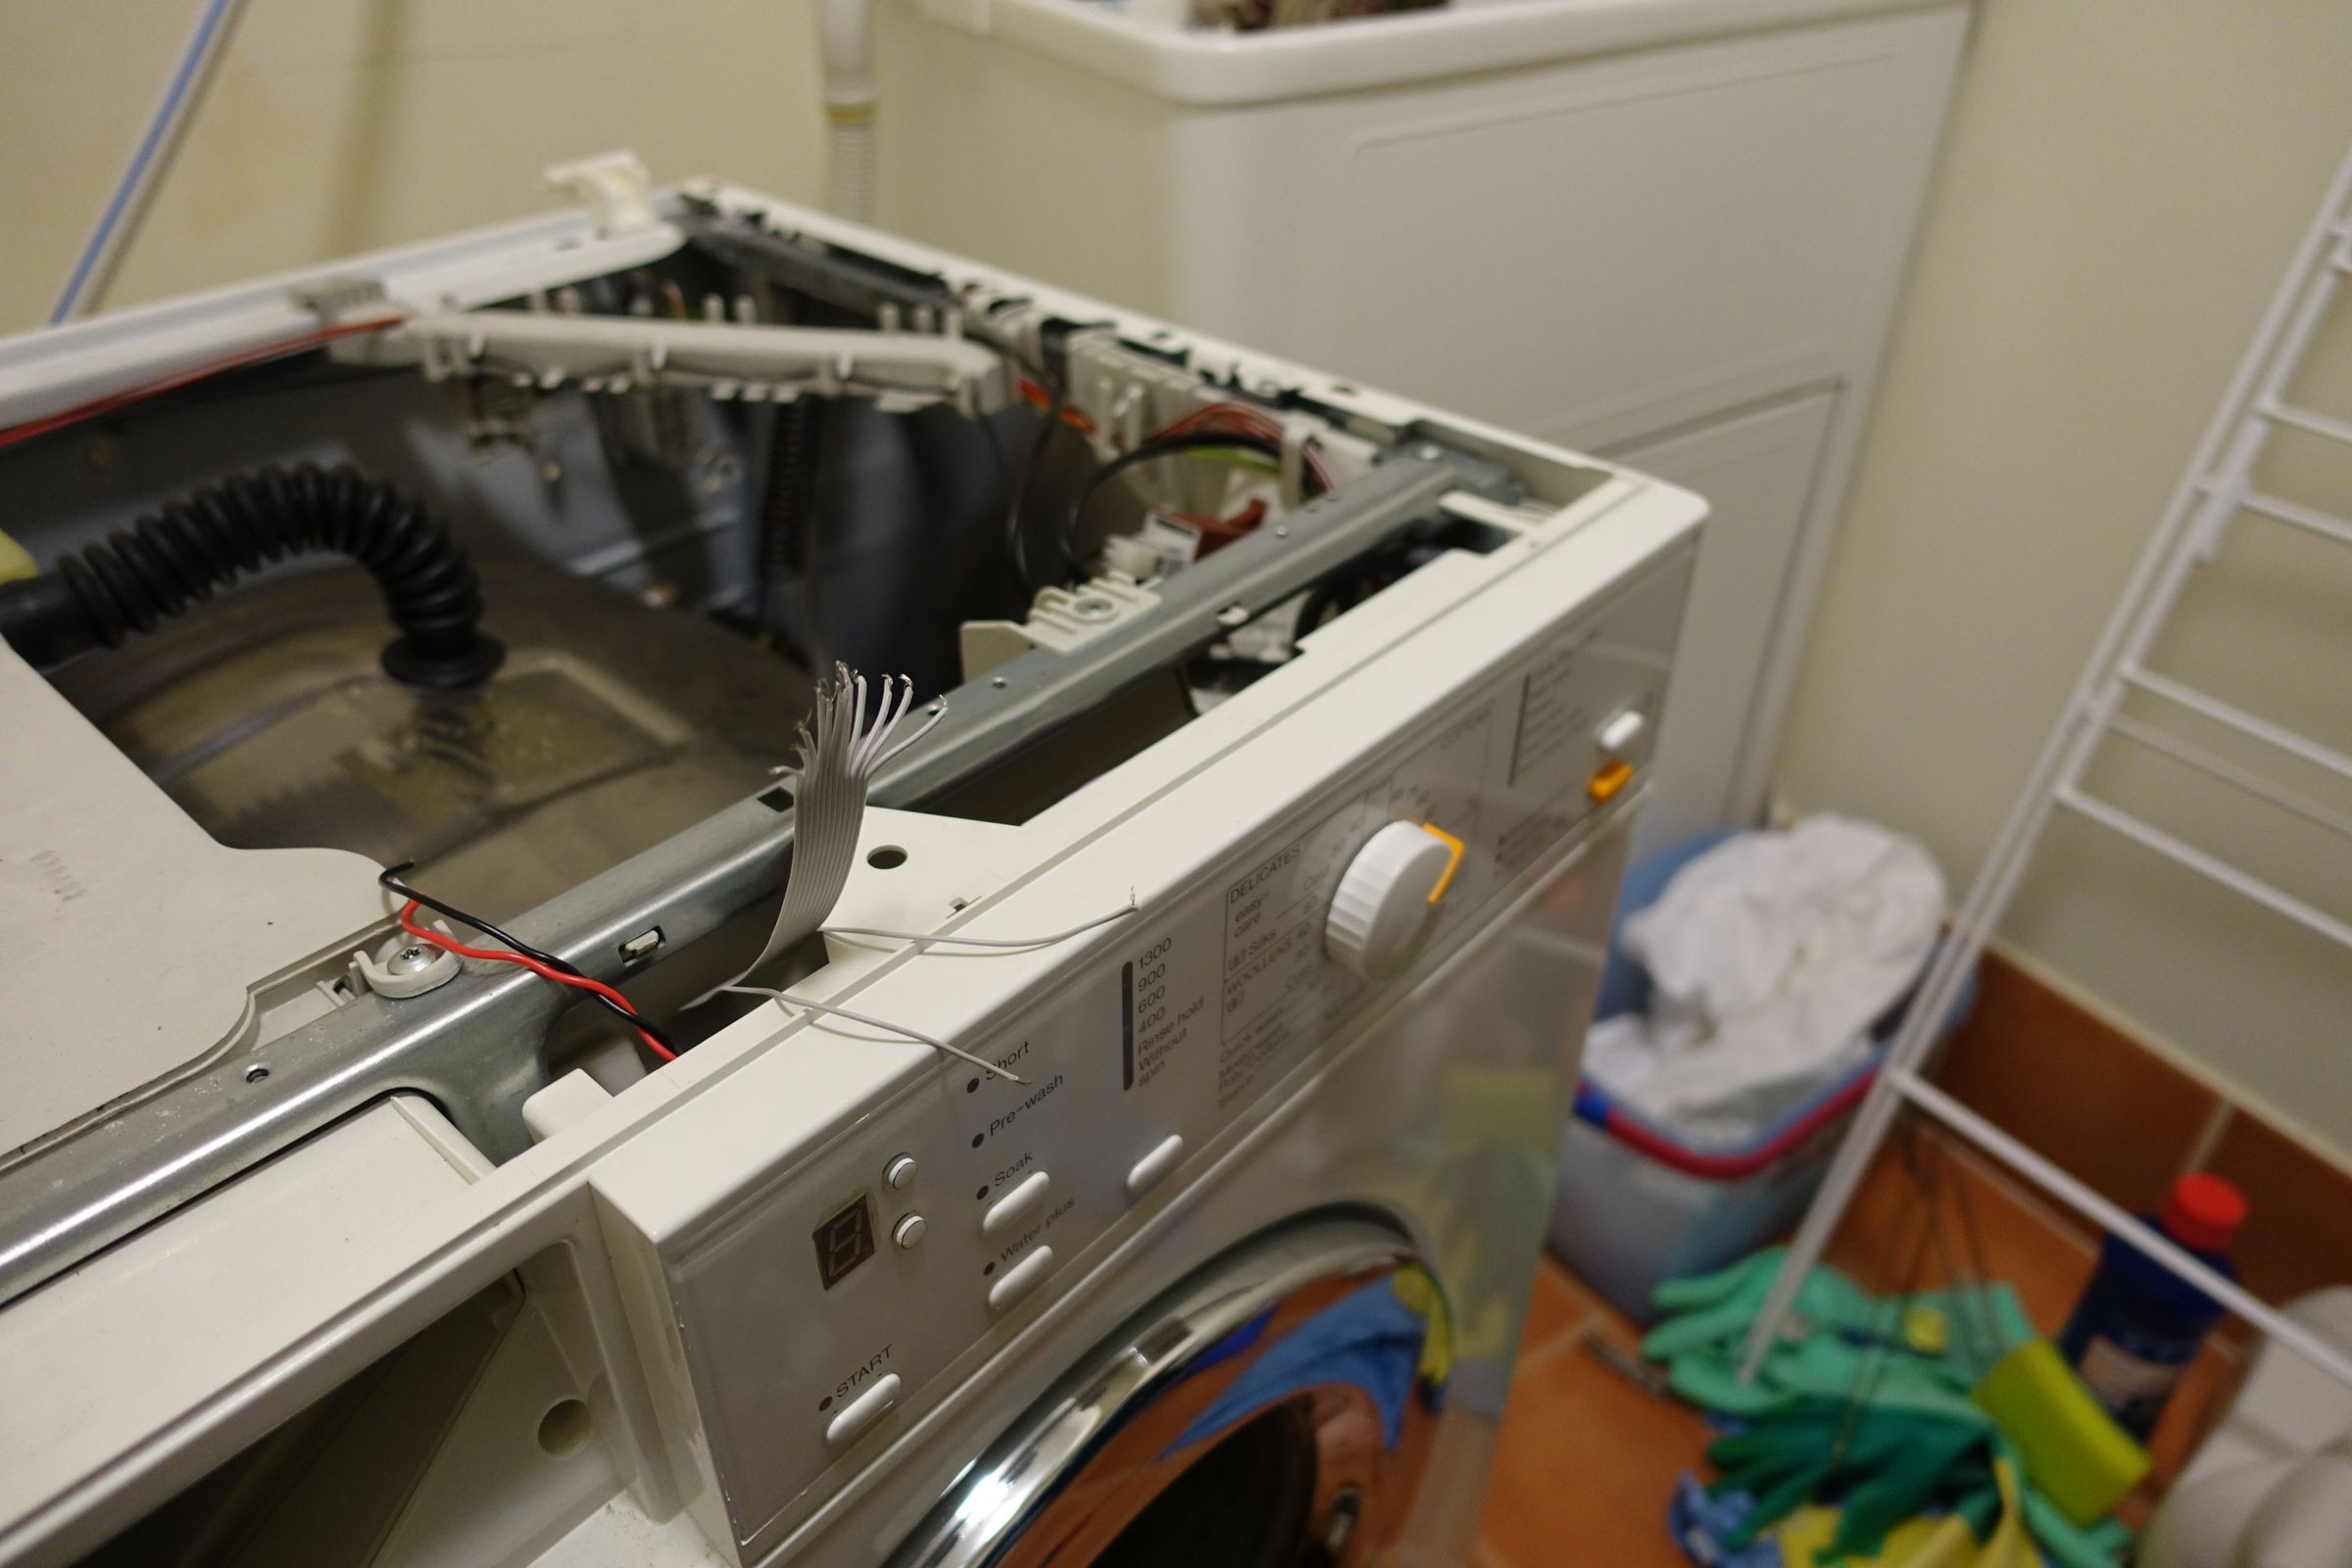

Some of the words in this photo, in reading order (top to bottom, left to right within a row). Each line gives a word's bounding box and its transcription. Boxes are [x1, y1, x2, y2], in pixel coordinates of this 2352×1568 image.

[1230, 843, 1300, 904] DELICATES
[1138, 937, 1172, 969] 1300
[1138, 963, 1166, 992] 900
[1138, 985, 1166, 1013] 600
[1138, 1006, 1165, 1034] 400
[1138, 1021, 1175, 1055] Rinse
[1139, 1027, 1187, 1071] Without
[1139, 1059, 1165, 1087] spin
[989, 1074, 1063, 1137] Pre-wash
[995, 1151, 1034, 1187] Soak
[1002, 1224, 1042, 1262] Water
[1046, 1197, 1075, 1229] plus
[837, 1343, 894, 1398] START
